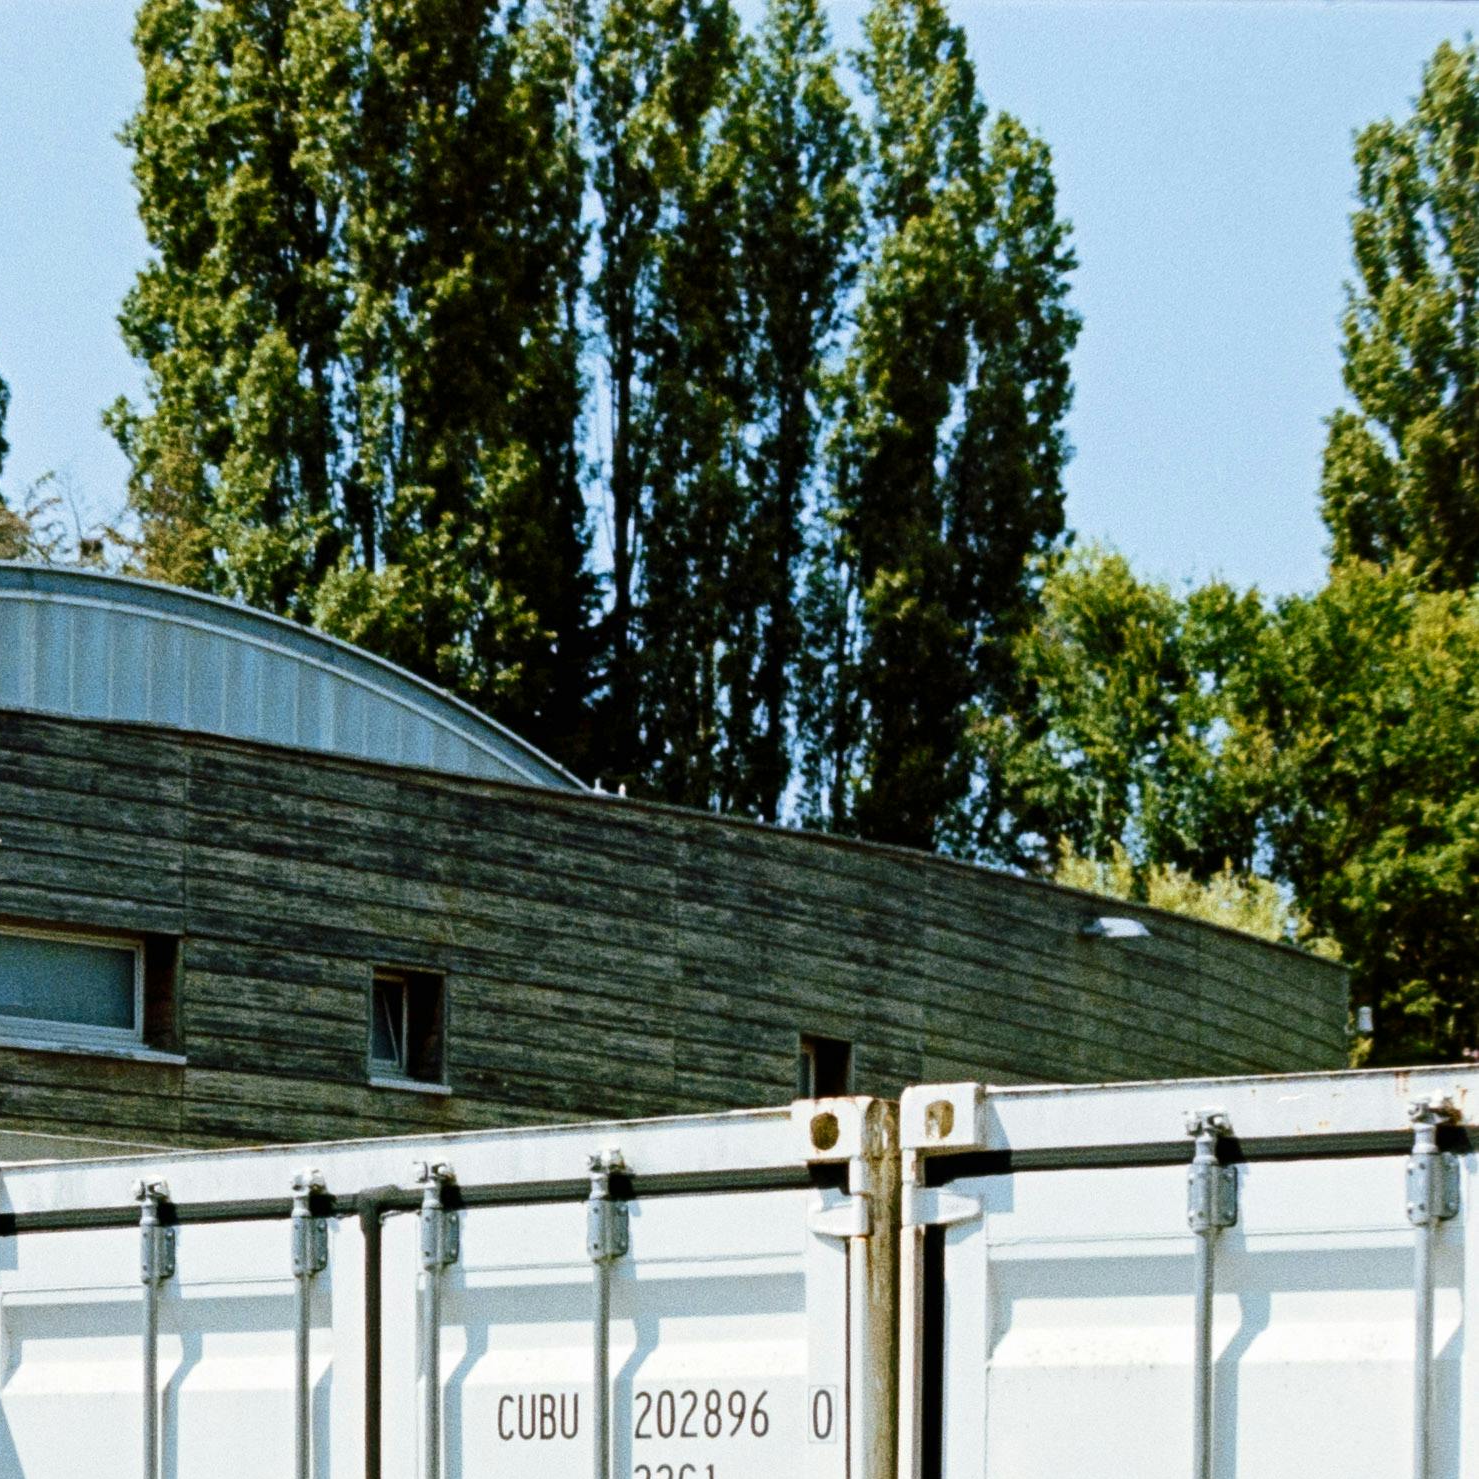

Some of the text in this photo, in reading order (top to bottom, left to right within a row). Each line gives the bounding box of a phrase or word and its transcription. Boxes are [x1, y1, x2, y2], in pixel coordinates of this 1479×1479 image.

[498, 1389, 833, 1441] CUBU 202896 0
